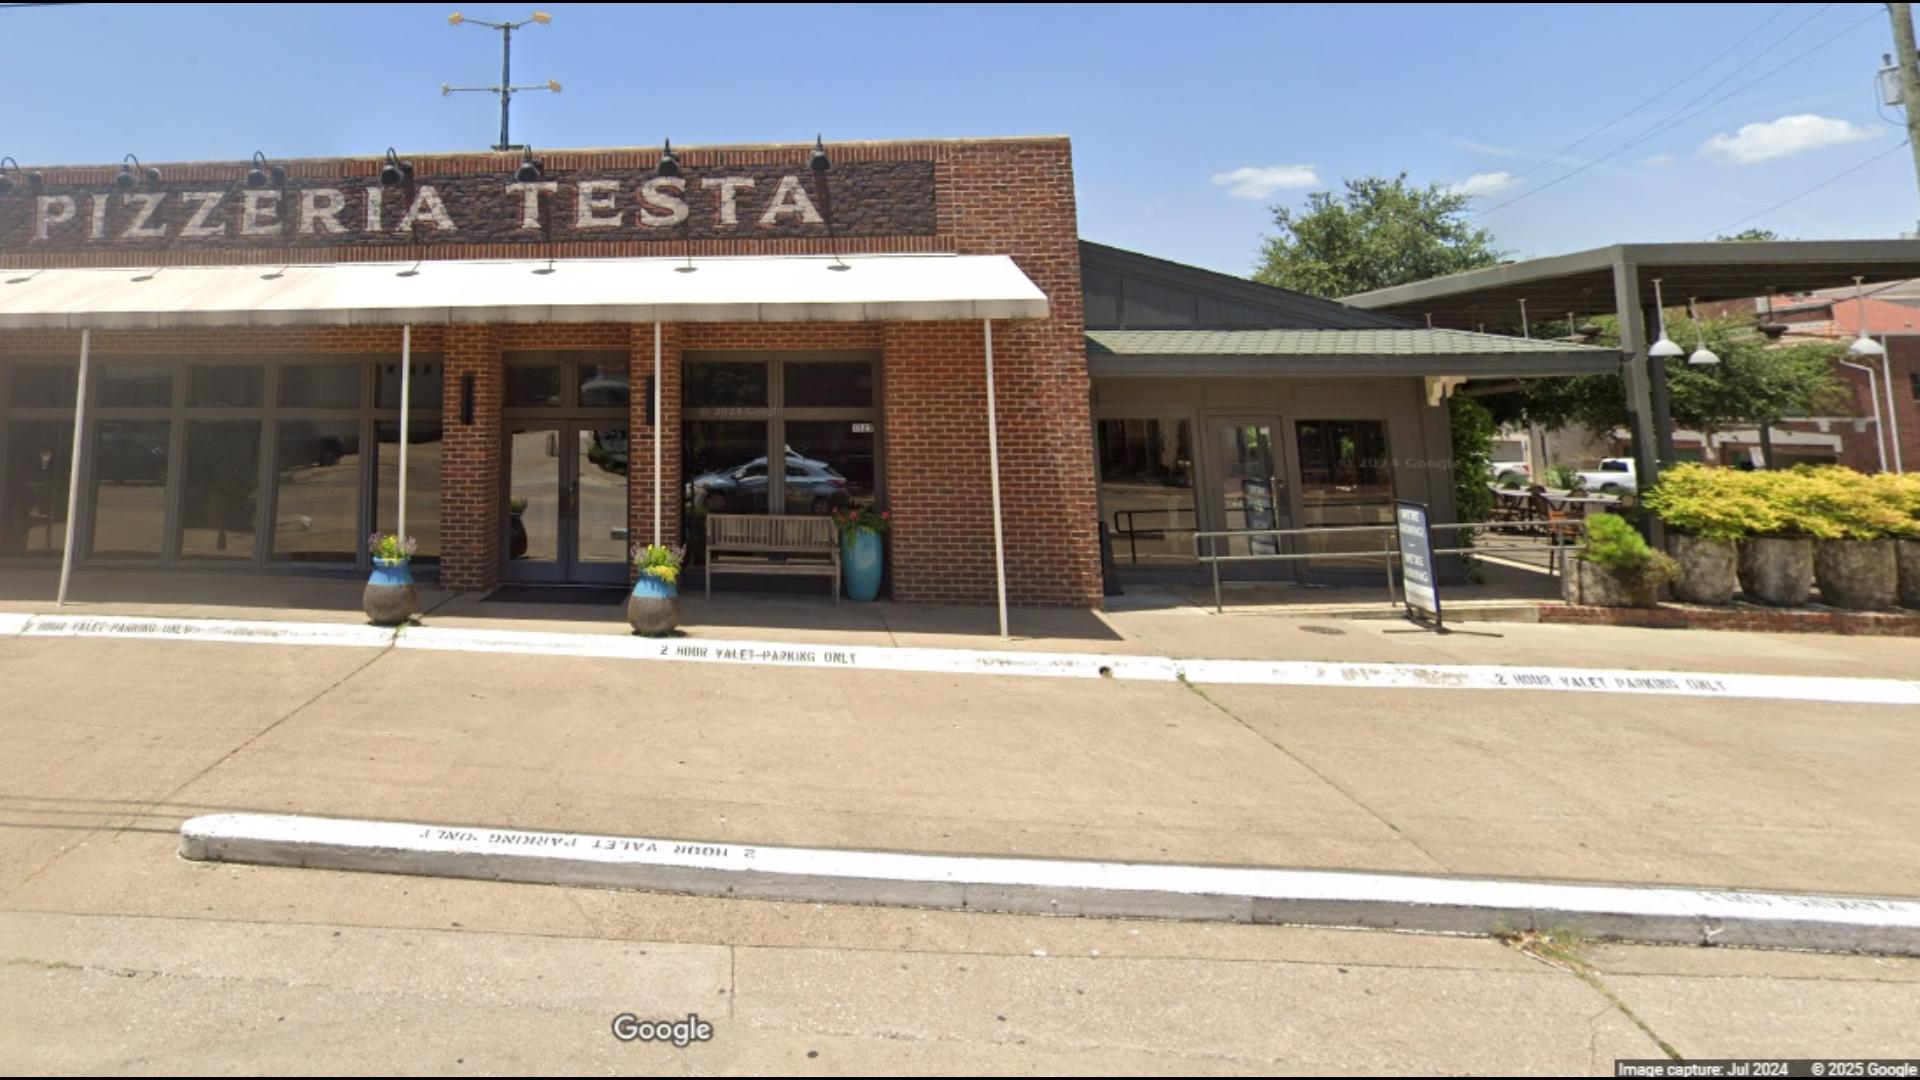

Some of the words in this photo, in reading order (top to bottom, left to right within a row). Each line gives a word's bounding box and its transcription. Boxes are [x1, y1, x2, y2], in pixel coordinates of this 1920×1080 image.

[34, 185, 458, 241] PIZZERIA
[505, 175, 825, 229] TESTA
[660, 645, 668, 656] 2
[676, 646, 708, 658] HOUR
[716, 648, 754, 661] VALET
[762, 649, 816, 663] PARKING
[824, 651, 856, 665] ONLY
[1494, 673, 1507, 686] 2
[1512, 673, 1551, 687] HOUR
[1559, 675, 1606, 689] VALET
[1614, 676, 1680, 691] PARKING
[1686, 678, 1728, 692] ONLY
[488, 832, 577, 848] PARKING
[592, 839, 658, 852] VALET
[673, 844, 728, 857] HOUR
[743, 848, 757, 858] 2
